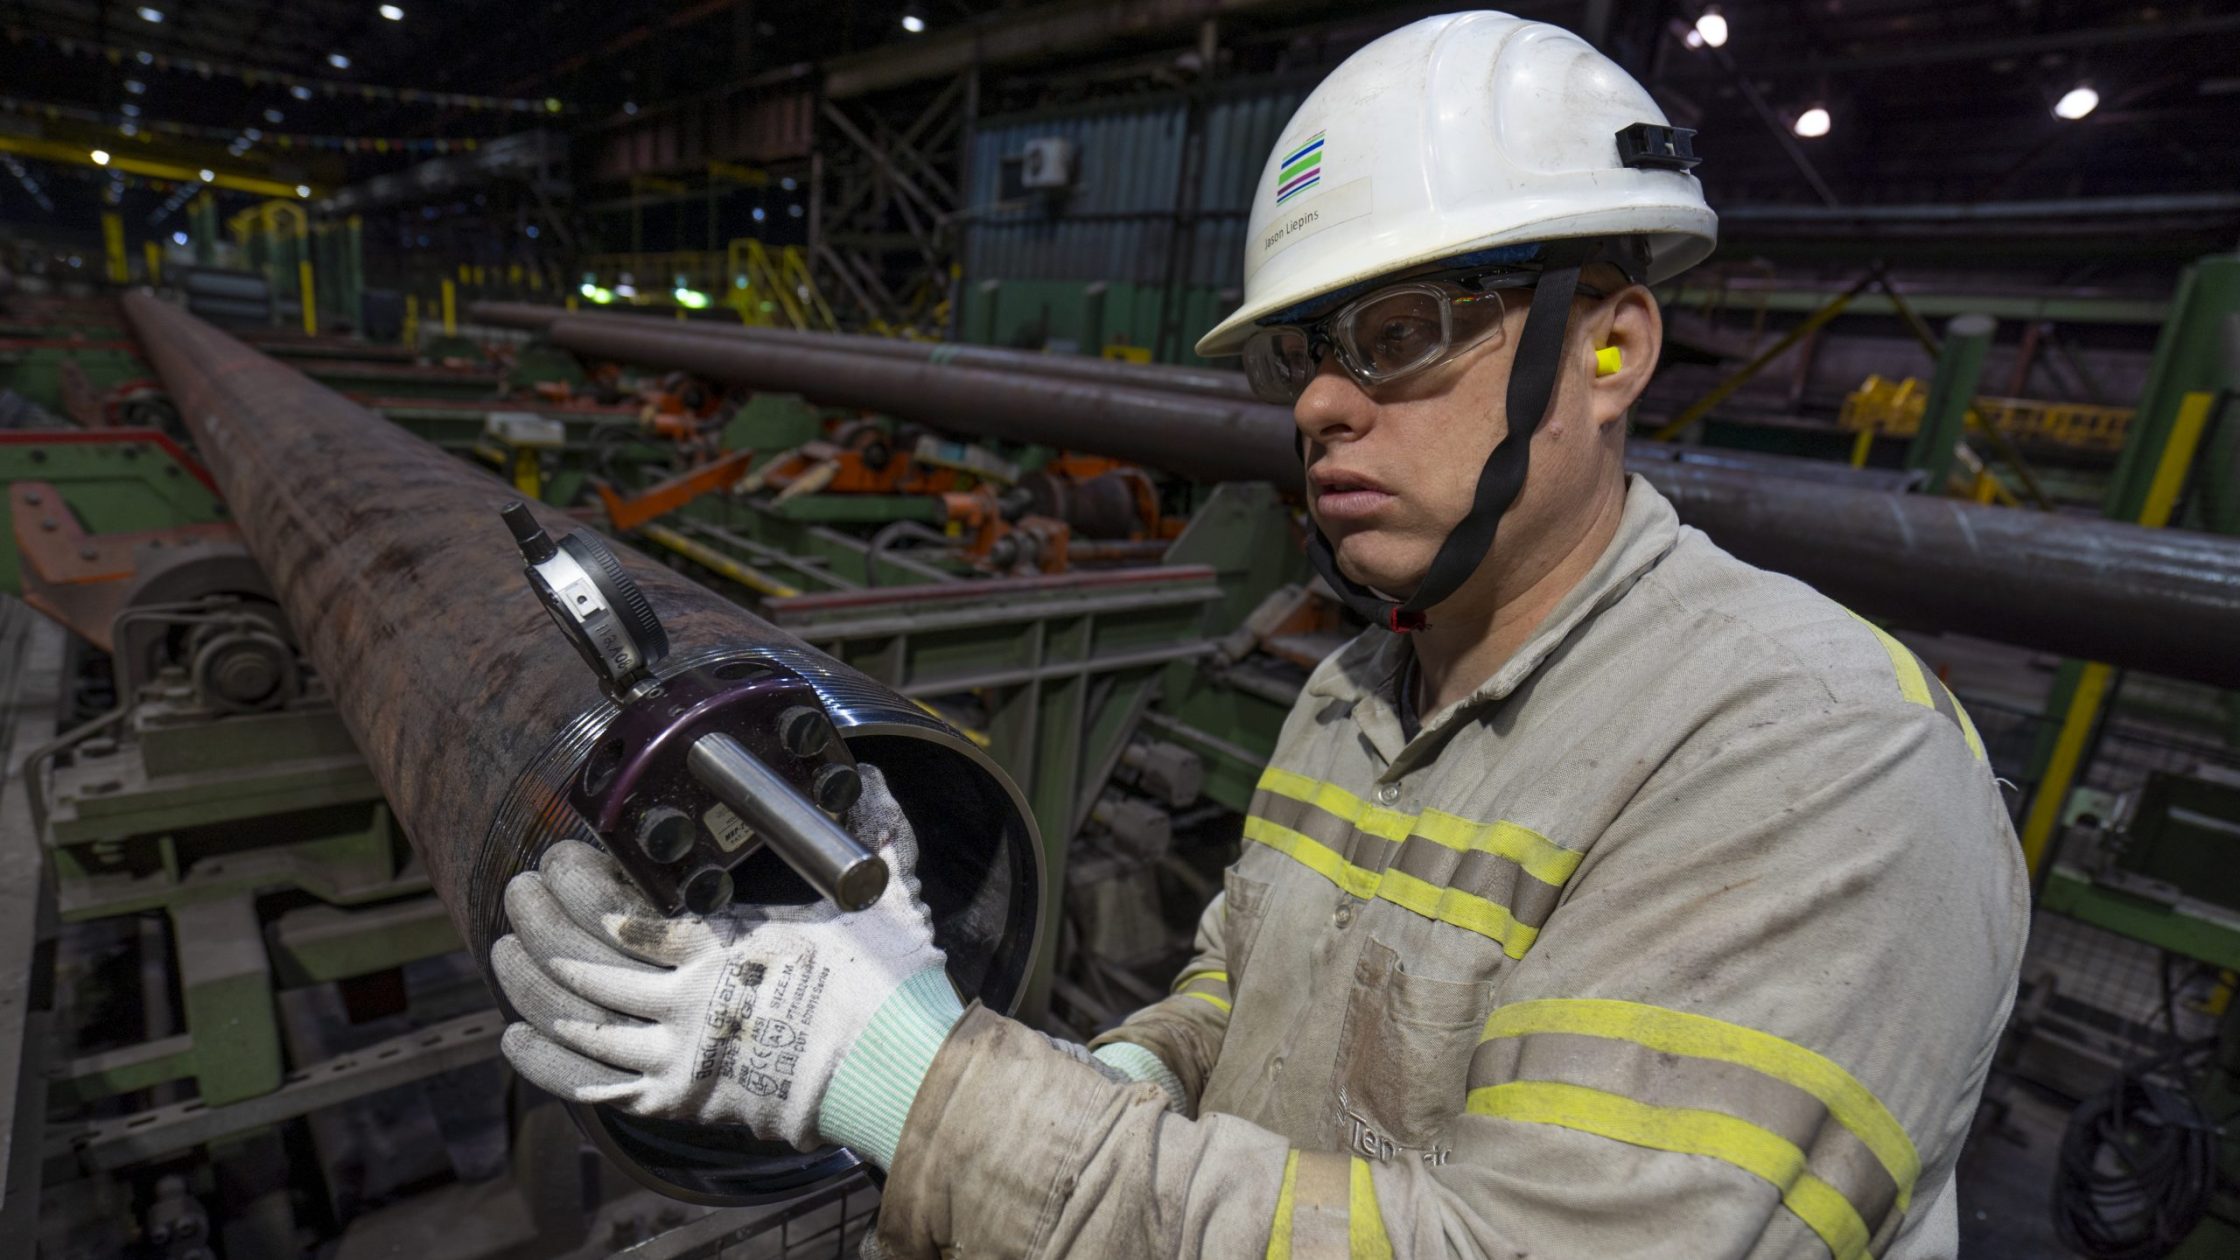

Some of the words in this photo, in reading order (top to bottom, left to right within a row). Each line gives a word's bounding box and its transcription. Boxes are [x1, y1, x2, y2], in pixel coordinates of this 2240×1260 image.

[1264, 229, 1284, 250] Jason
[1286, 210, 1319, 235] Liepins
[708, 959, 742, 1030] Guard
[751, 1016, 767, 1042] ANSI
[769, 1023, 786, 1047] A4
[794, 1031, 809, 1052] CUT
